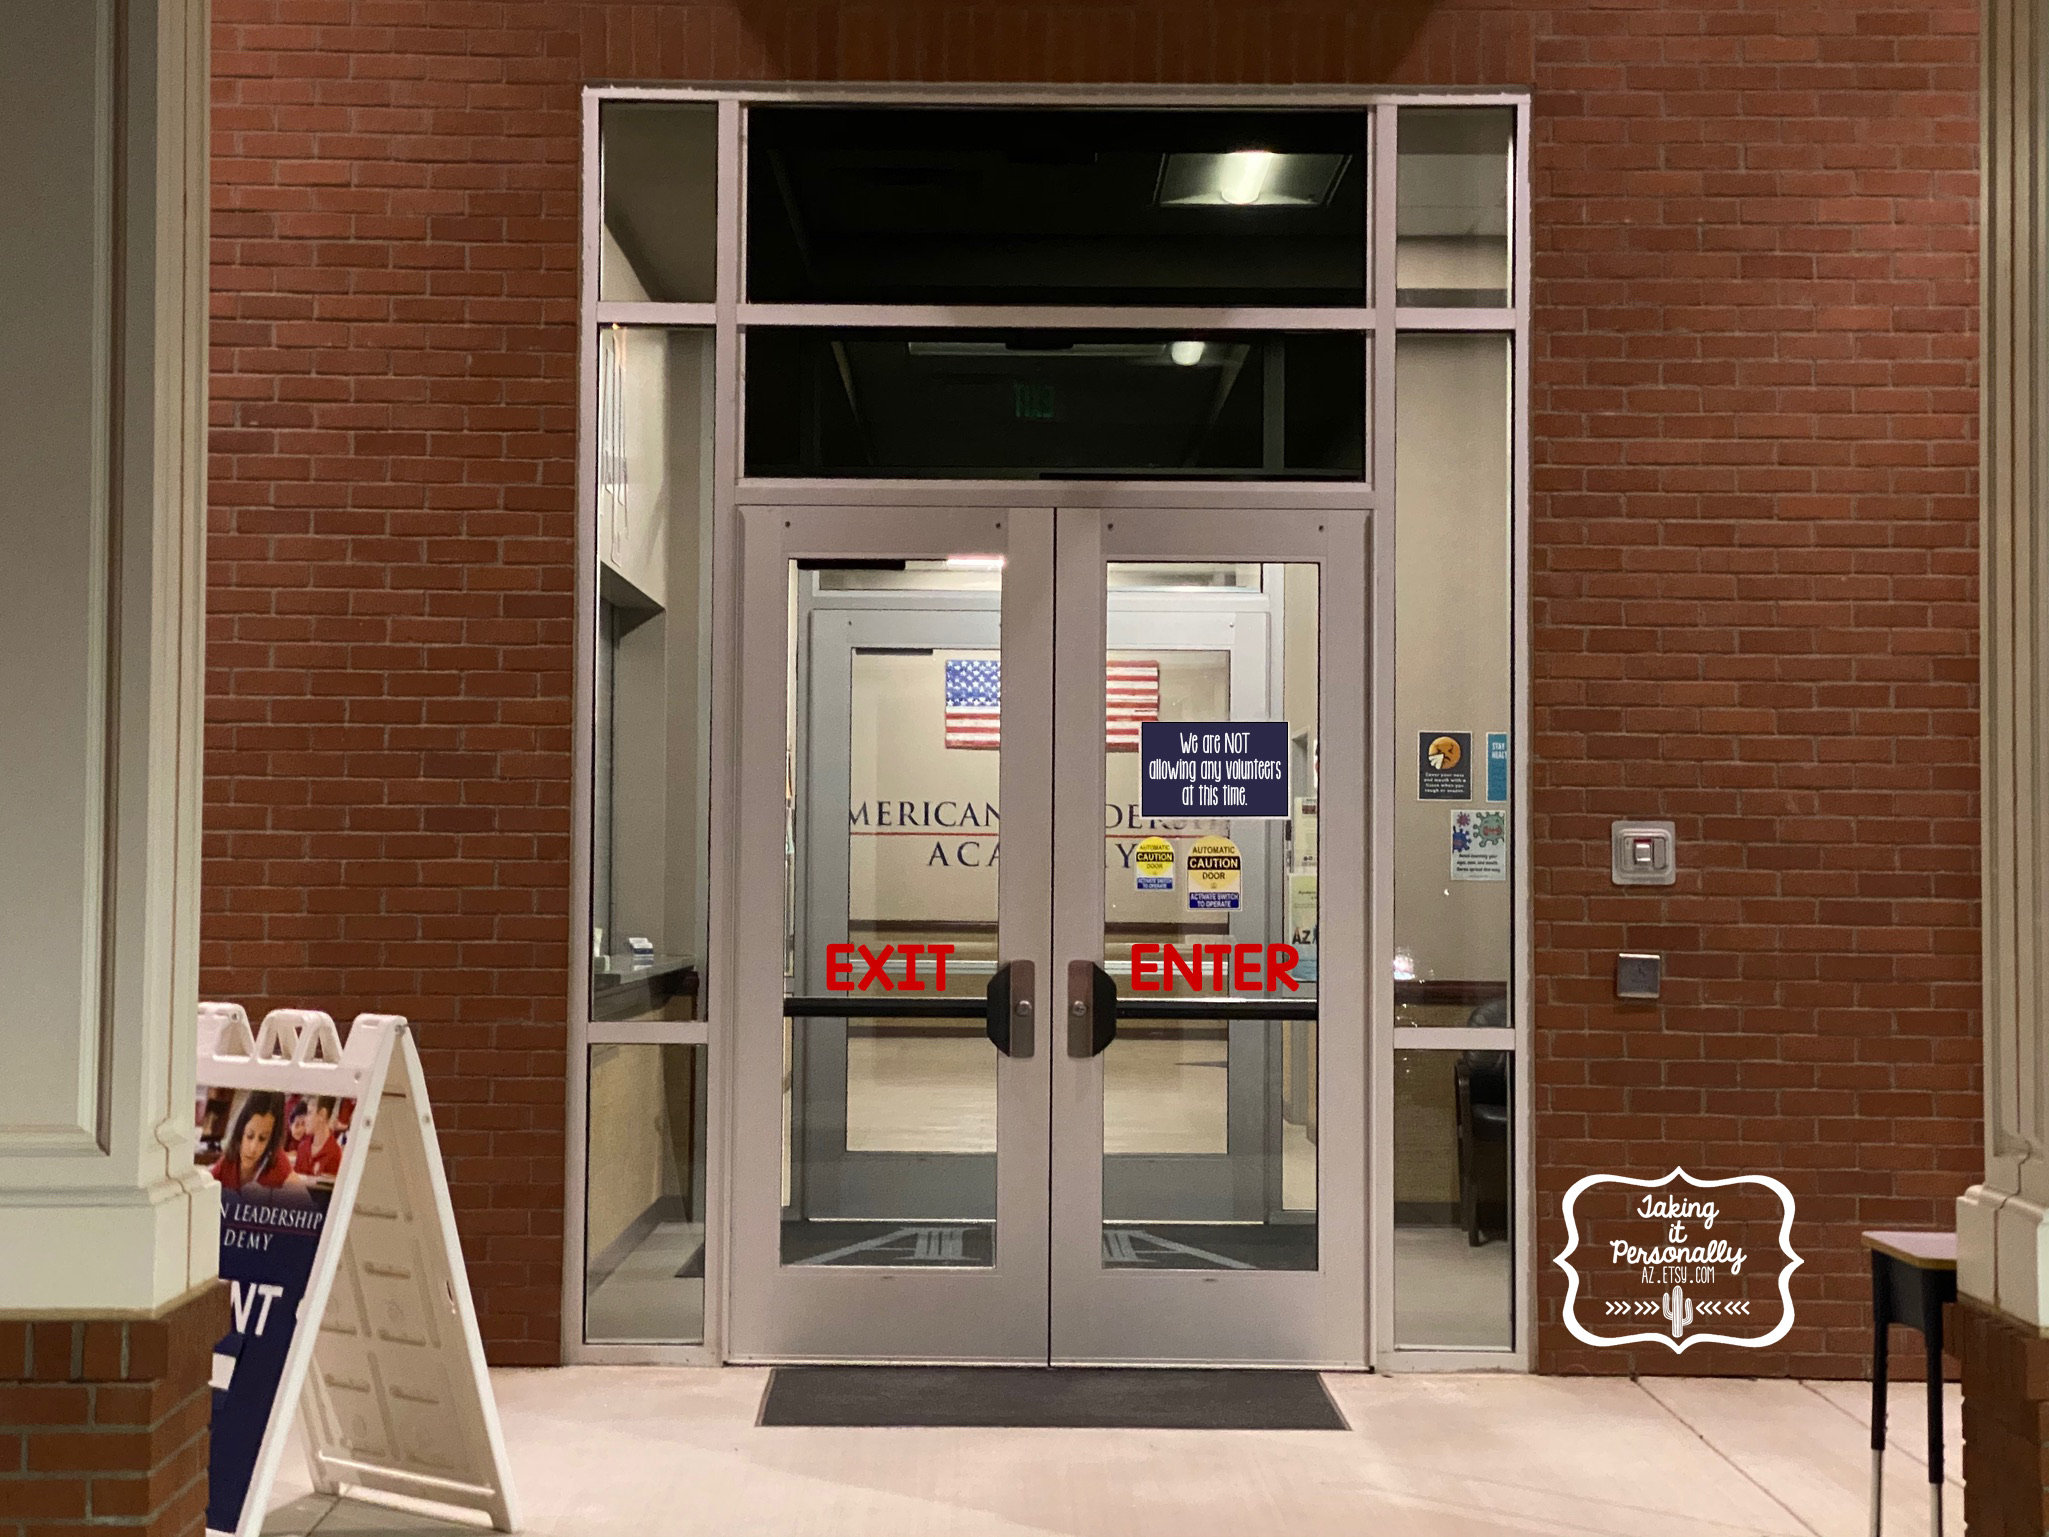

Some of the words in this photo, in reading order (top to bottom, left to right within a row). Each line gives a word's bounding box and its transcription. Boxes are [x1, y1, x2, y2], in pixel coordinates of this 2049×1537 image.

[1179, 732, 1199, 754] We
[1202, 734, 1221, 754] are
[1224, 732, 1251, 754] NOT
[1148, 758, 1197, 783] allowing
[1200, 760, 1222, 783] any
[1225, 758, 1283, 780] volunteers
[1181, 784, 1195, 806] at
[1198, 784, 1219, 806] this
[1222, 784, 1249, 806] time.
[850, 801, 1000, 827] MERICAN
[1138, 853, 1172, 861] CAUTION
[1192, 846, 1235, 854] AUTOMATIC
[1189, 858, 1238, 869] CAUTION
[1202, 872, 1226, 880] DOOR
[826, 943, 955, 992] EXIT
[1131, 942, 1300, 992] ENTER
[234, 1203, 323, 1231] LEADERSHIP
[224, 1229, 274, 1251] DEMY
